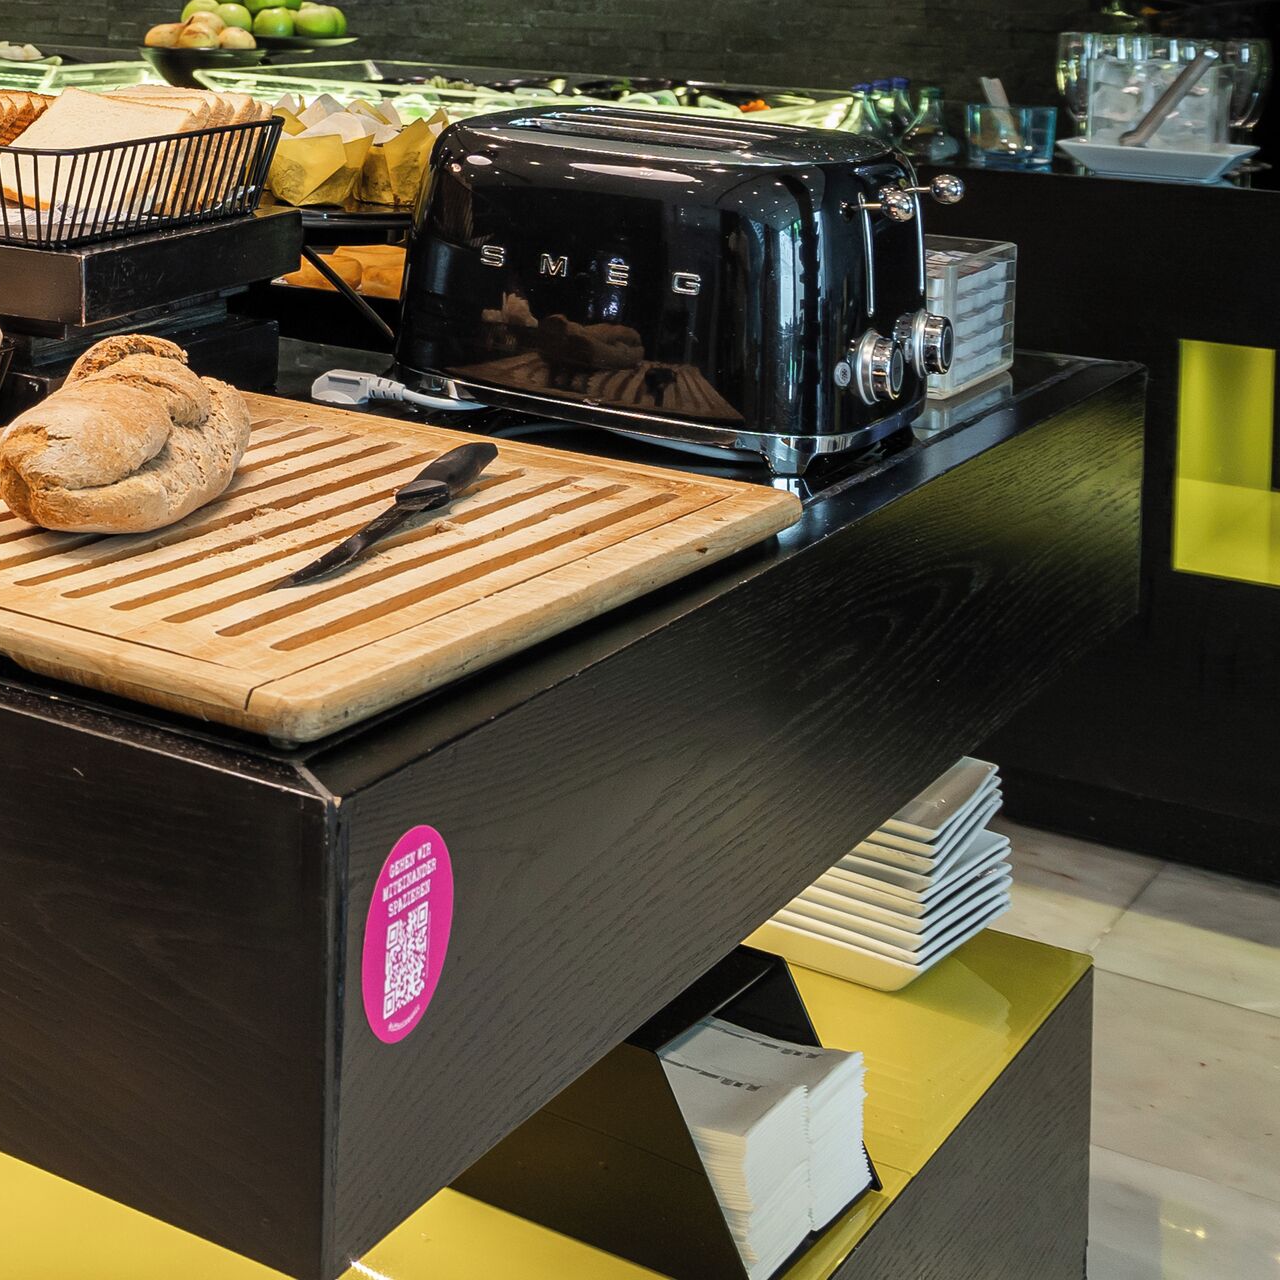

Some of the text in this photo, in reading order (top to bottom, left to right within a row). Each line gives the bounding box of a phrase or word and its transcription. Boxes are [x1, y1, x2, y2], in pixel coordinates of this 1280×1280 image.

[480, 244, 701, 296] SMEG
[382, 857, 437, 902] MITEINANDER
[388, 878, 431, 918] SPAZIEREN
